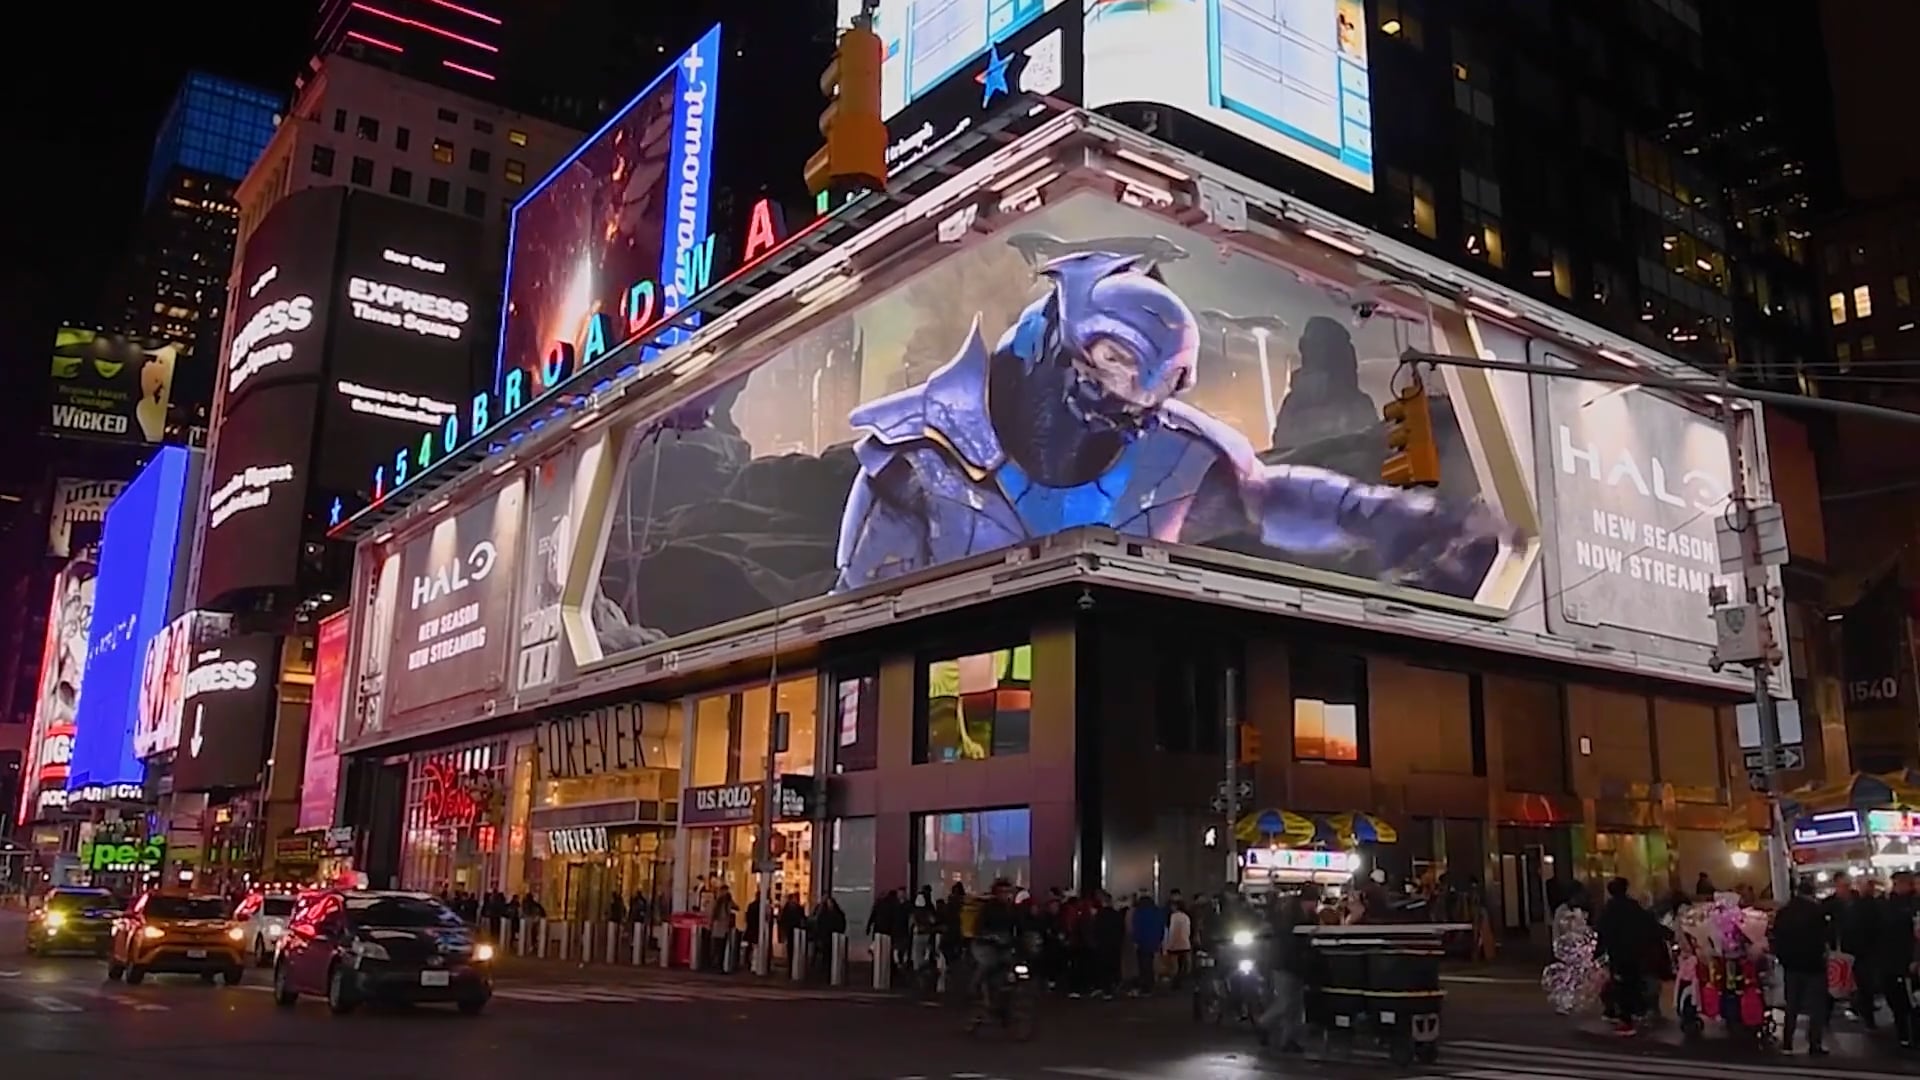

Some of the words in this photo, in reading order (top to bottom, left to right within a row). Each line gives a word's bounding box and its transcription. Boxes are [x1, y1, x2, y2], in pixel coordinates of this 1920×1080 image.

[349, 277, 469, 323] EXPRESS
[352, 300, 401, 327] Times
[403, 313, 461, 339] Square
[374, 414, 458, 501] 1540
[1559, 425, 1735, 516] HALO
[1576, 540, 1622, 575] NOW
[1593, 509, 1636, 543] NEW
[1643, 524, 1715, 565] SEASON
[411, 541, 497, 610] HALO
[419, 618, 439, 642] NEW
[440, 602, 480, 635] SEASON
[408, 647, 430, 671] NOW
[430, 626, 486, 664] STREAMING
[1849, 677, 1898, 702] 1540
[536, 702, 646, 781] FOREVER
[717, 786, 751, 808] POLO
[549, 828, 595, 855] FOREVER
